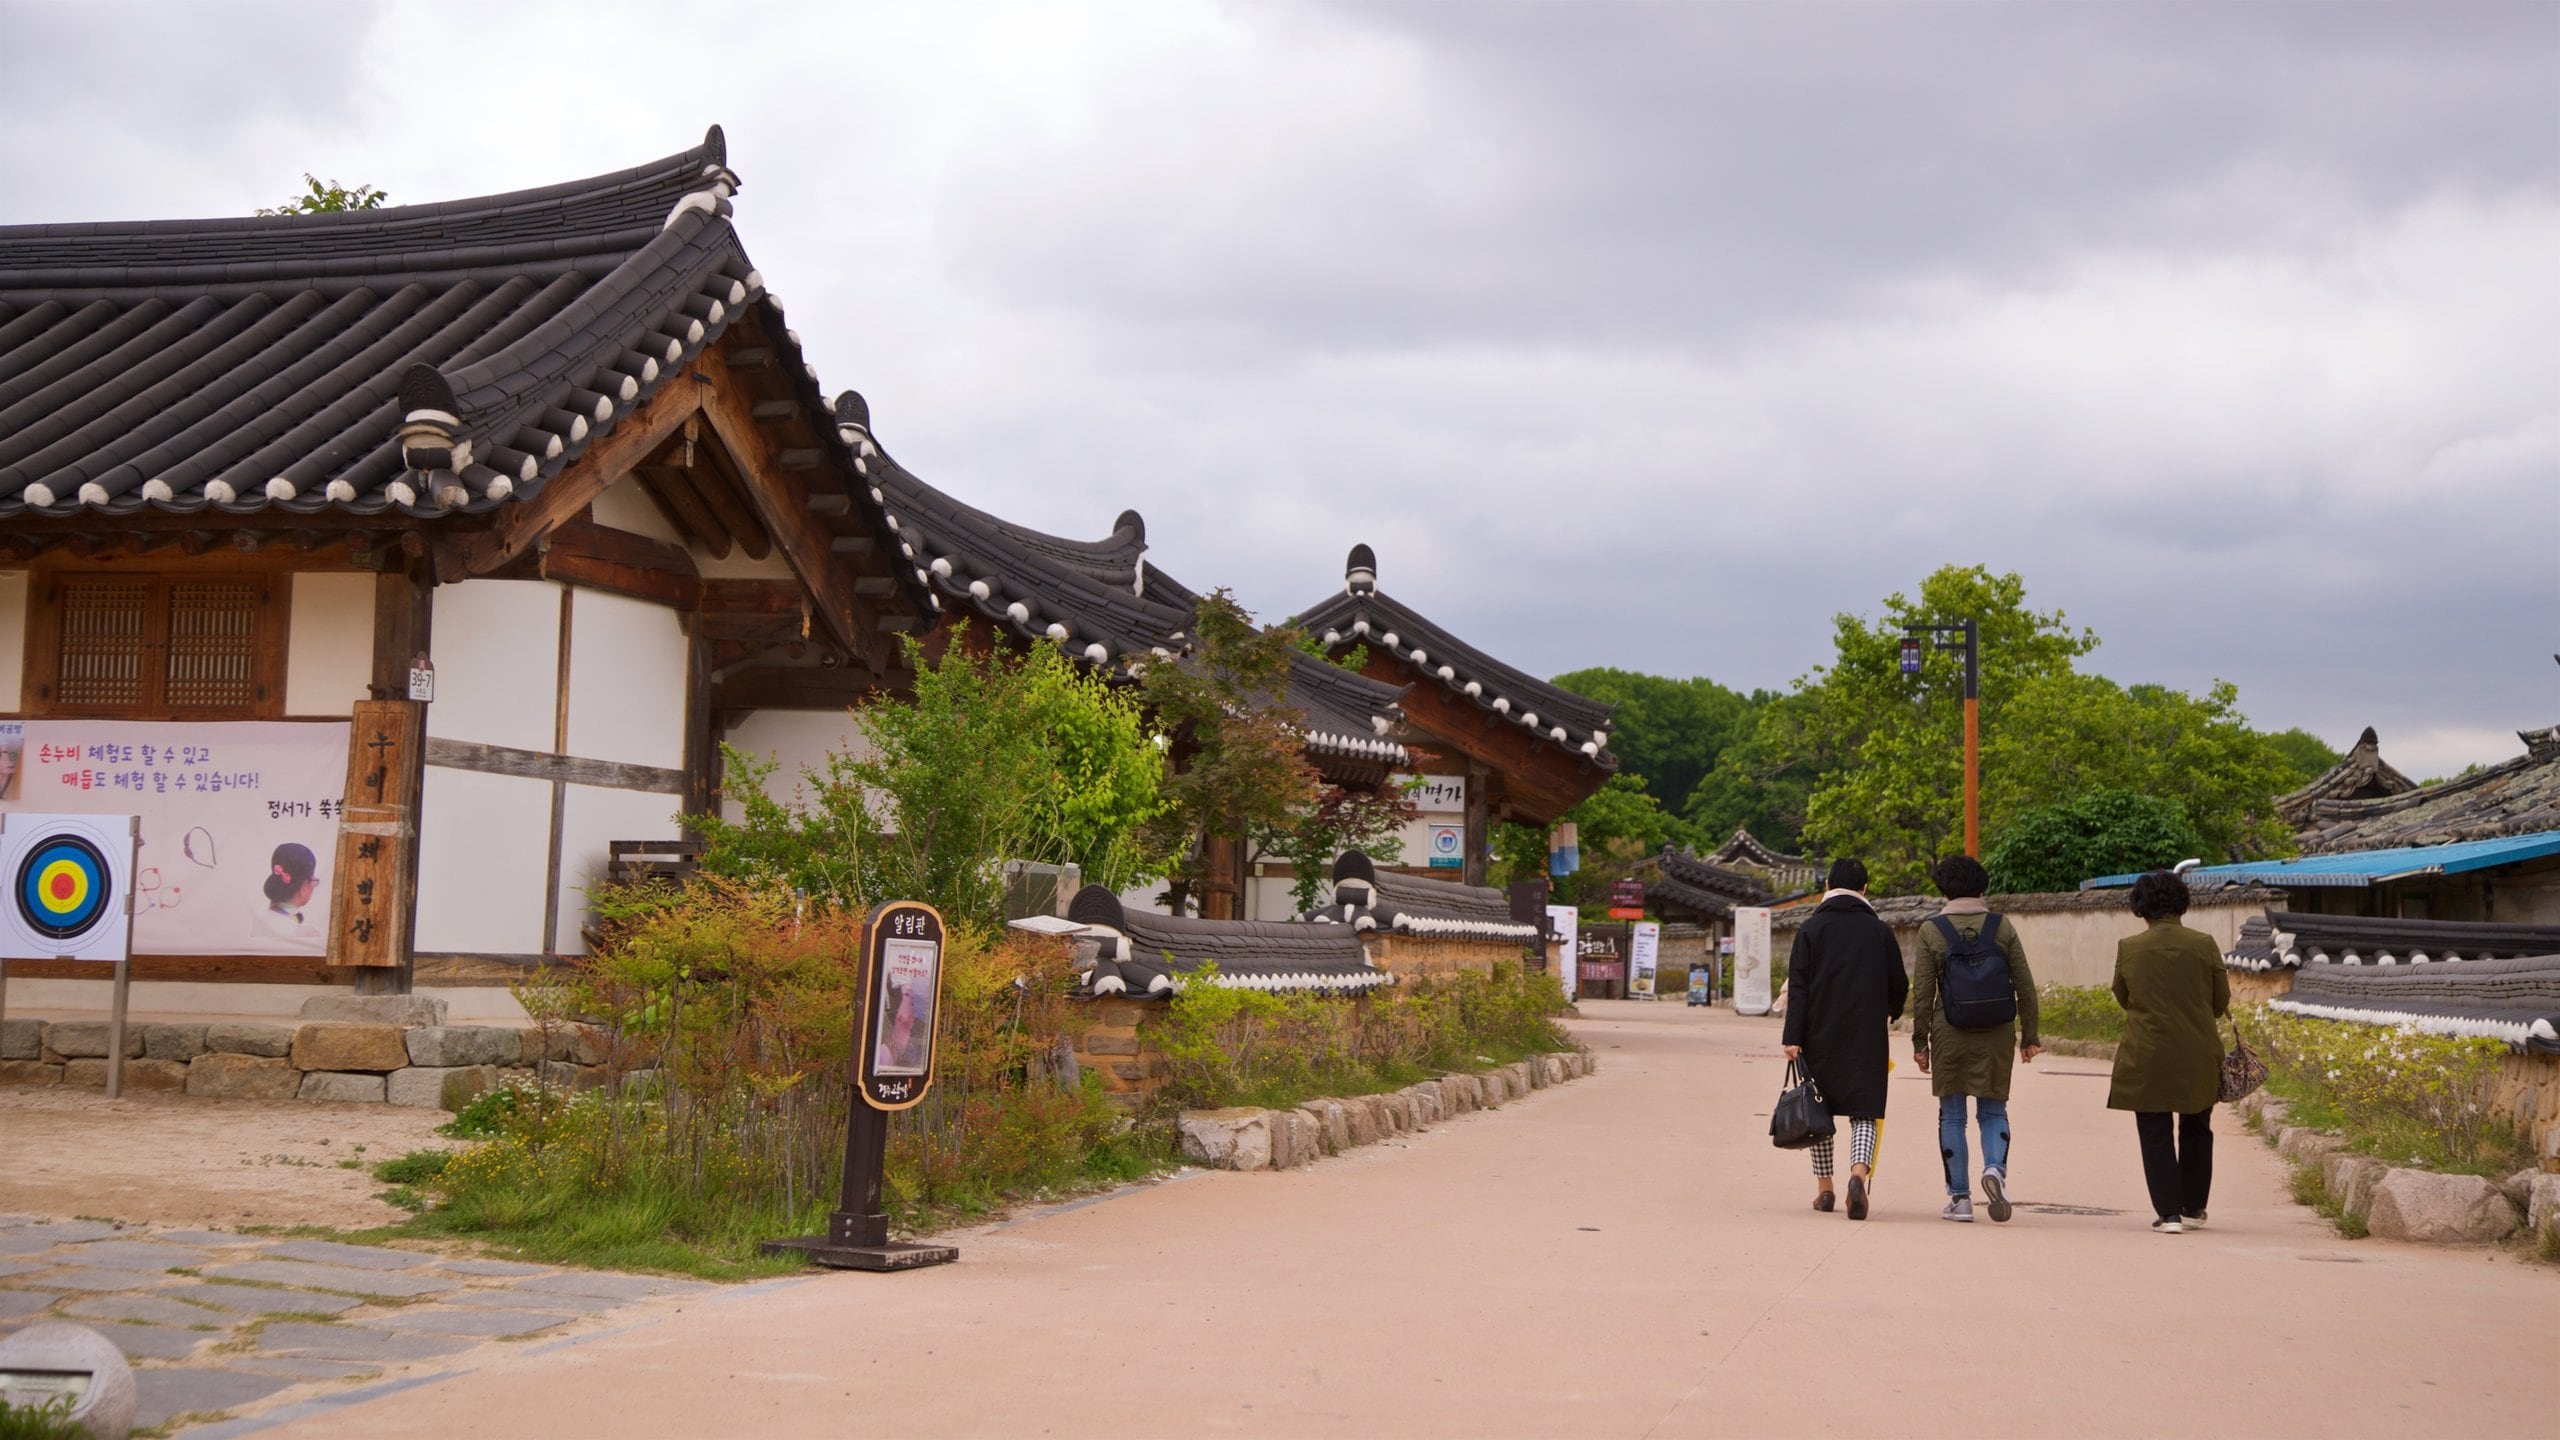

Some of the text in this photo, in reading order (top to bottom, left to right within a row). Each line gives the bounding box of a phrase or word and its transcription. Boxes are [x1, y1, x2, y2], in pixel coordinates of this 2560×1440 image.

[411, 671, 431, 688] 39-7
[39, 744, 210, 766] 손누비 체험도 할 수 있고
[366, 731, 396, 804] 누비
[62, 769, 260, 793] 매듭도 체험 할 수 있습니다!
[1425, 783, 1462, 804] 명가
[268, 800, 312, 819] 정서가
[350, 836, 384, 943] 체험장
[894, 914, 926, 935] 알림판
